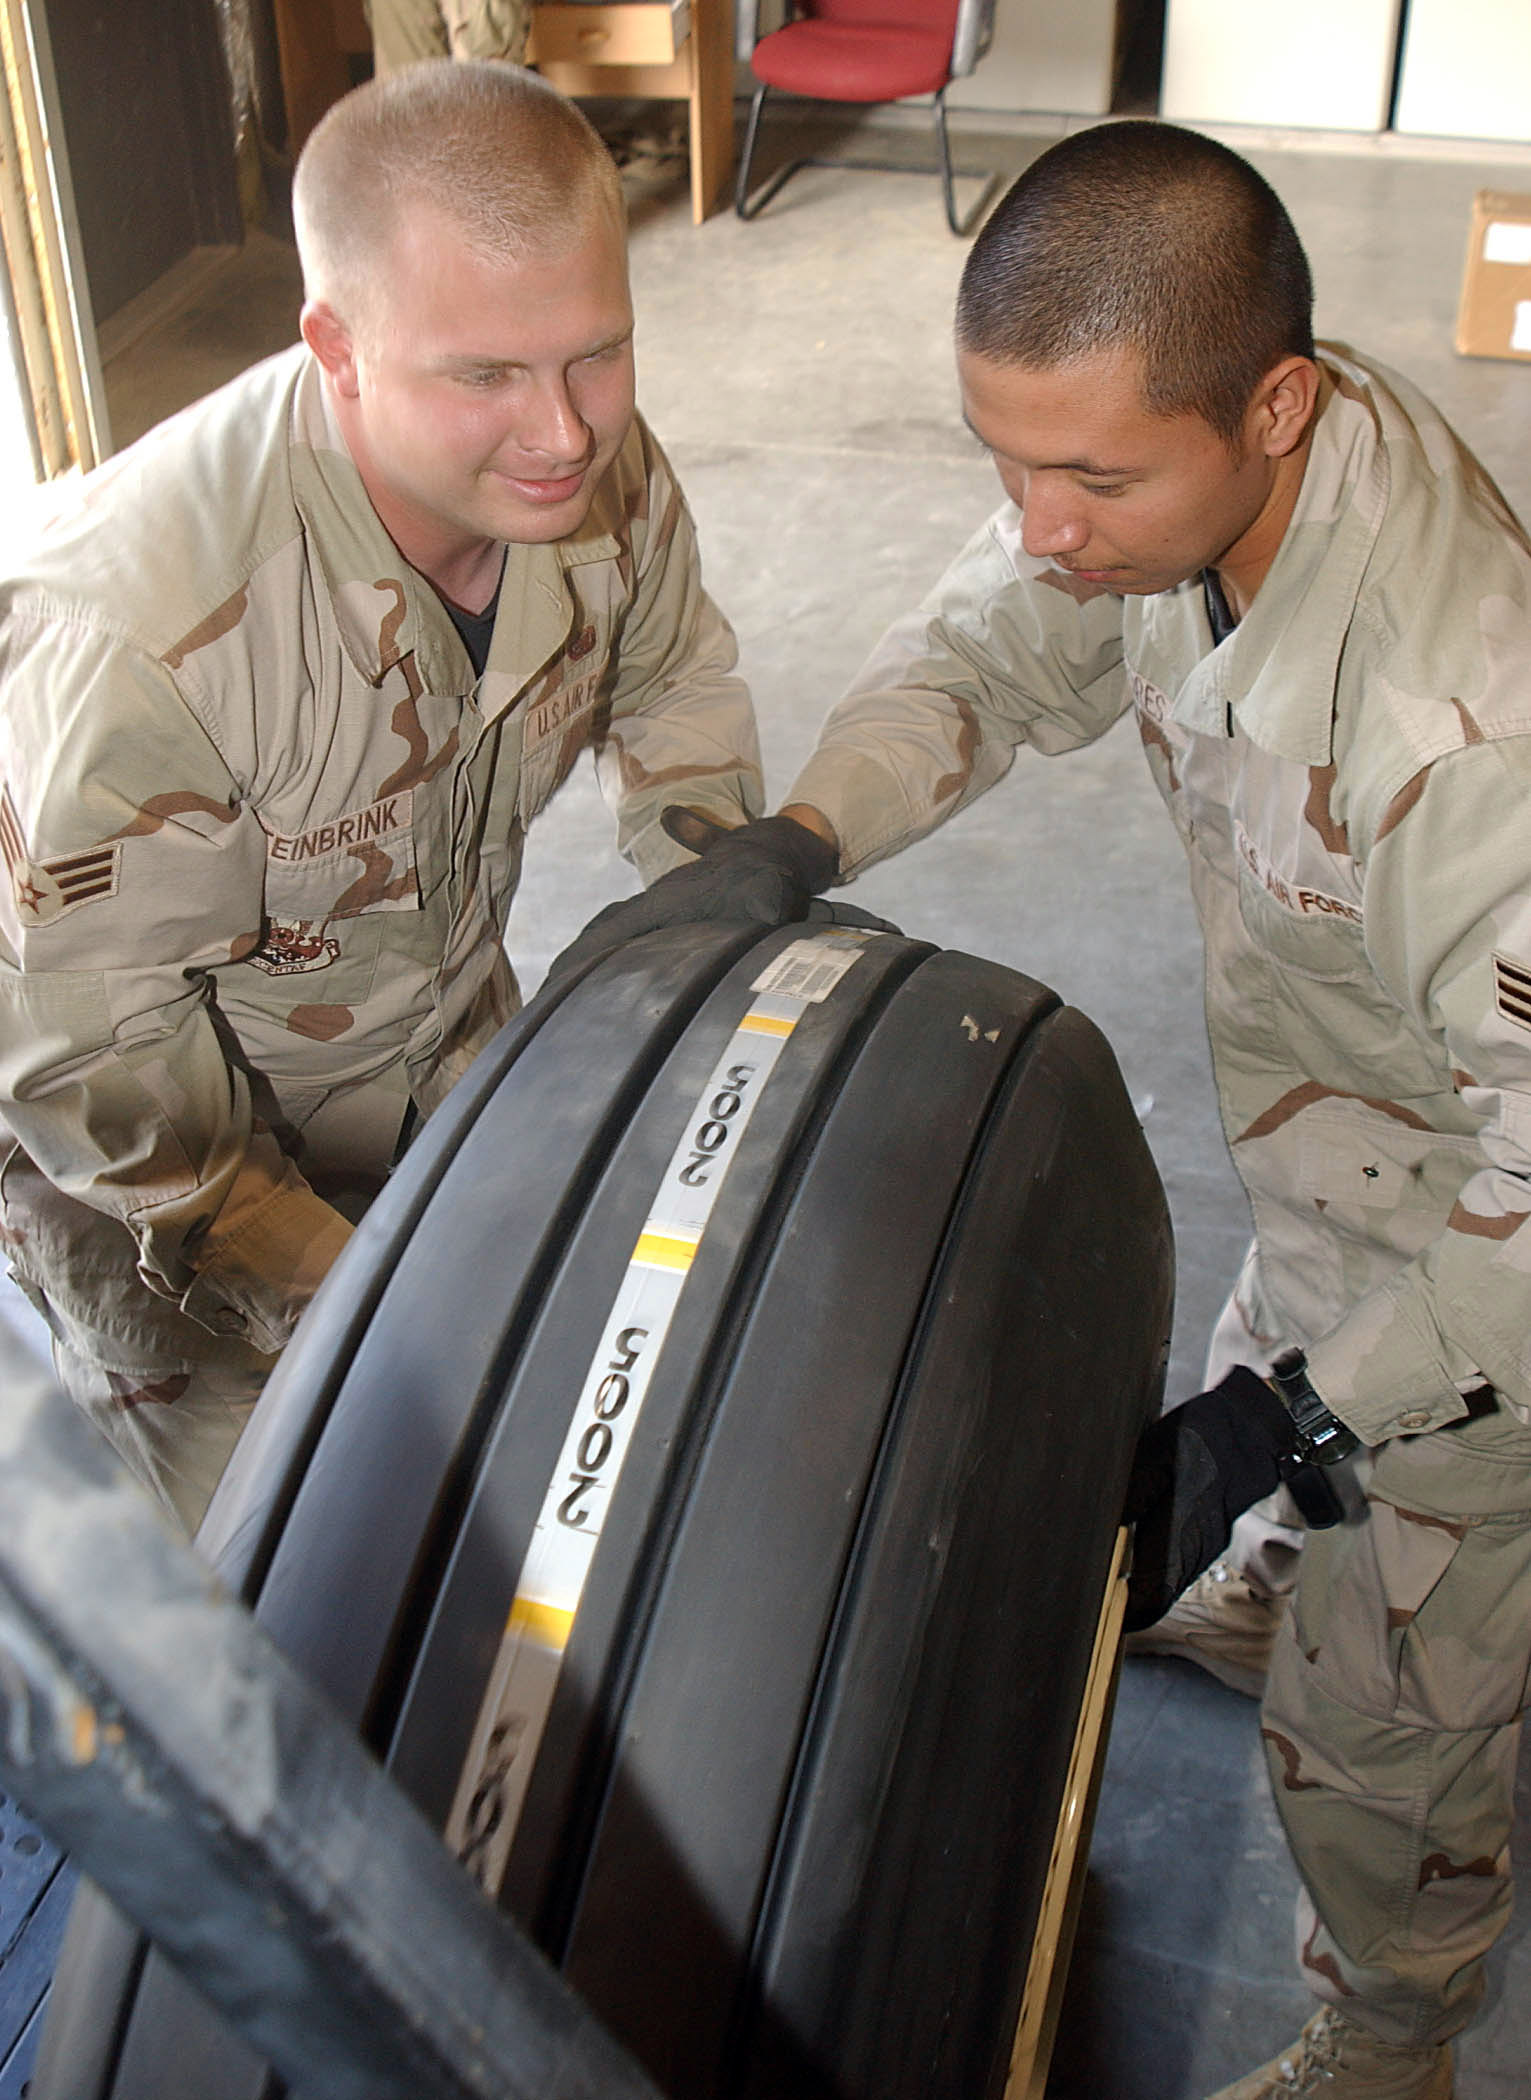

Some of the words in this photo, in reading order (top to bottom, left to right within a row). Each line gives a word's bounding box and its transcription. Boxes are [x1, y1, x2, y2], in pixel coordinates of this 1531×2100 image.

[265, 799, 398, 861] EINBRINK
[678, 1064, 756, 1188] 2005
[556, 1326, 650, 1529] 2005
